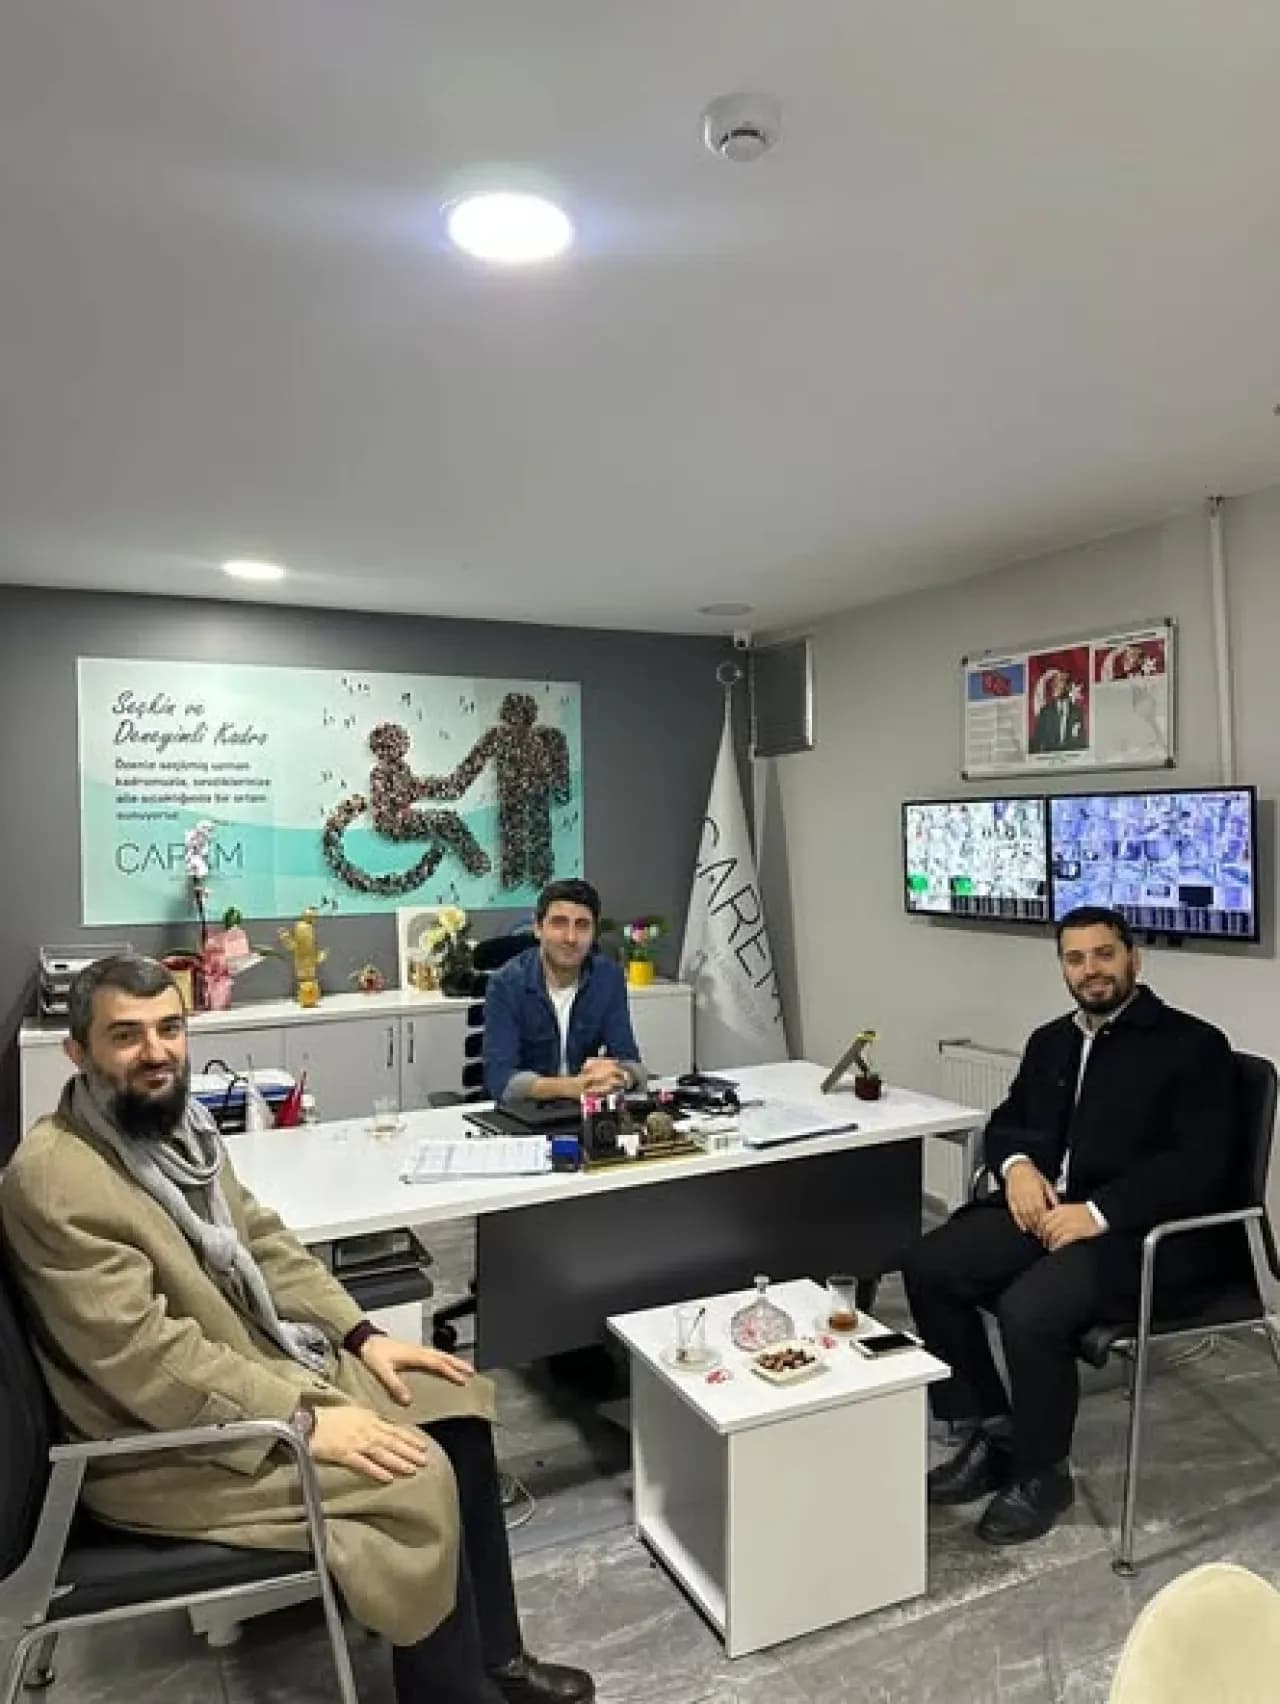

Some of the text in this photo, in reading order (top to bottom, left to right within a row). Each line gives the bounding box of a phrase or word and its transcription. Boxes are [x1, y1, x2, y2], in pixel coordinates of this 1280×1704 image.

[112, 690, 205, 719] Seçkin ve
[113, 719, 269, 754] Deneyimli Kadro
